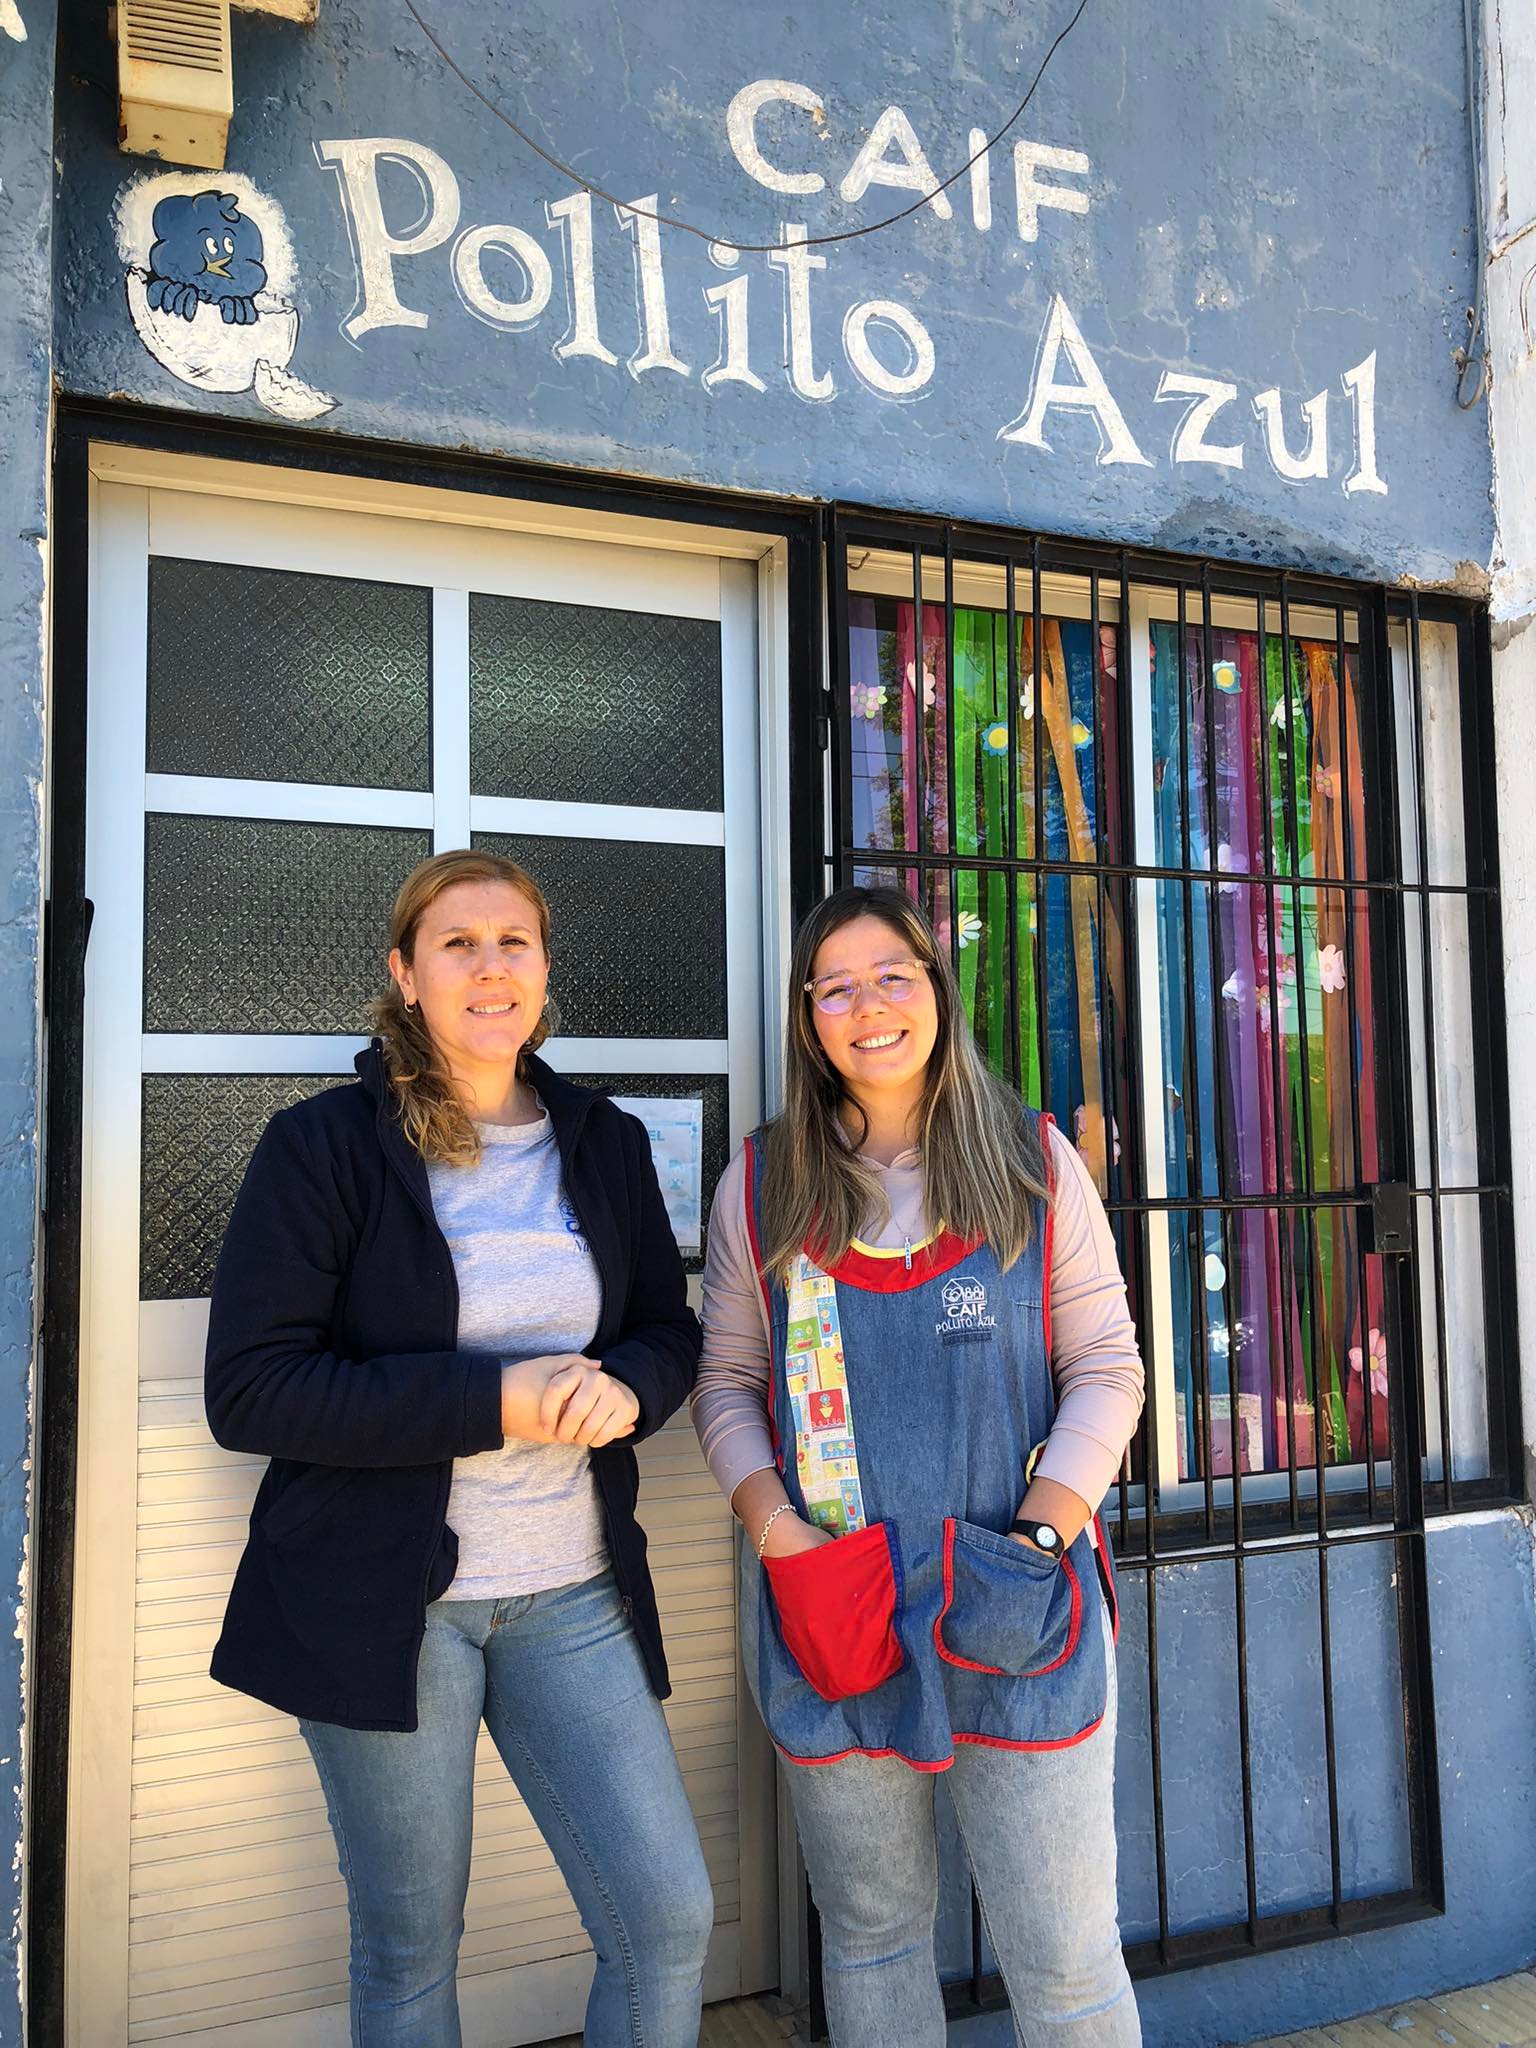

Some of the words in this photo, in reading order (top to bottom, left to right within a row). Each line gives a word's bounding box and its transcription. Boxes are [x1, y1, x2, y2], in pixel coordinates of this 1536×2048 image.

[725, 79, 1091, 243] CAIF
[312, 137, 936, 403] Pollito
[996, 293, 1388, 498] Azul
[936, 1318, 972, 1334] POLLITO
[978, 1314, 997, 1327] AZUL
[947, 1303, 986, 1317] CAIF
